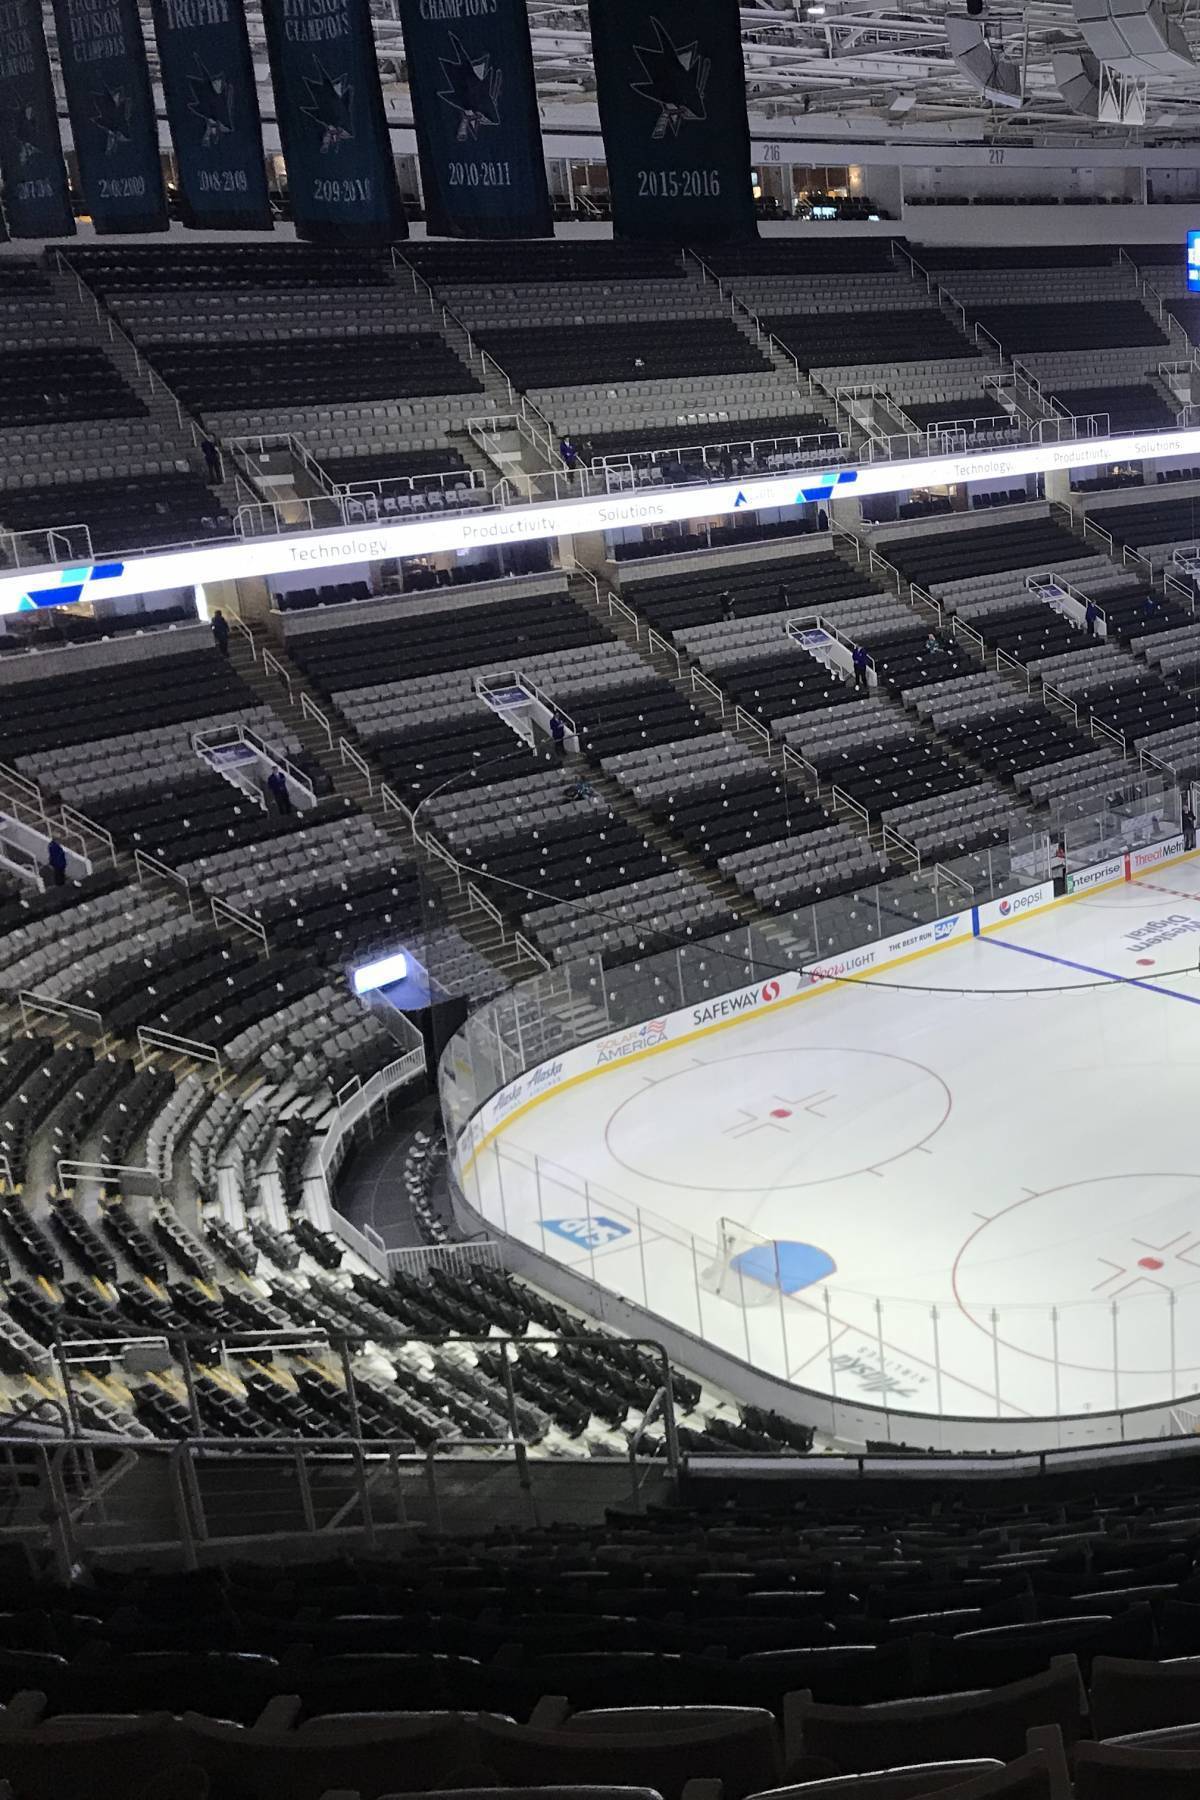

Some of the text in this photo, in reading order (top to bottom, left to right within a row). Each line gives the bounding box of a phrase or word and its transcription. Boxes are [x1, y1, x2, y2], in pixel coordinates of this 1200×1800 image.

[763, 144, 780, 161] 216
[989, 149, 1005, 165] 217
[448, 161, 511, 186] 2010-2011
[637, 170, 720, 198] 2015-2016
[1135, 843, 1185, 867] ThreatMetri
[1012, 893, 1043, 913] pepsi
[888, 921, 955, 952] THE BEST RUN SAP
[810, 951, 876, 984] Coors LIGHT
[693, 990, 759, 1026] SAFEWAY
[596, 1031, 639, 1051] SOLAR
[596, 1031, 668, 1065] AMERICA
[527, 1061, 563, 1087] Alaska
[558, 1219, 624, 1246] SAP
